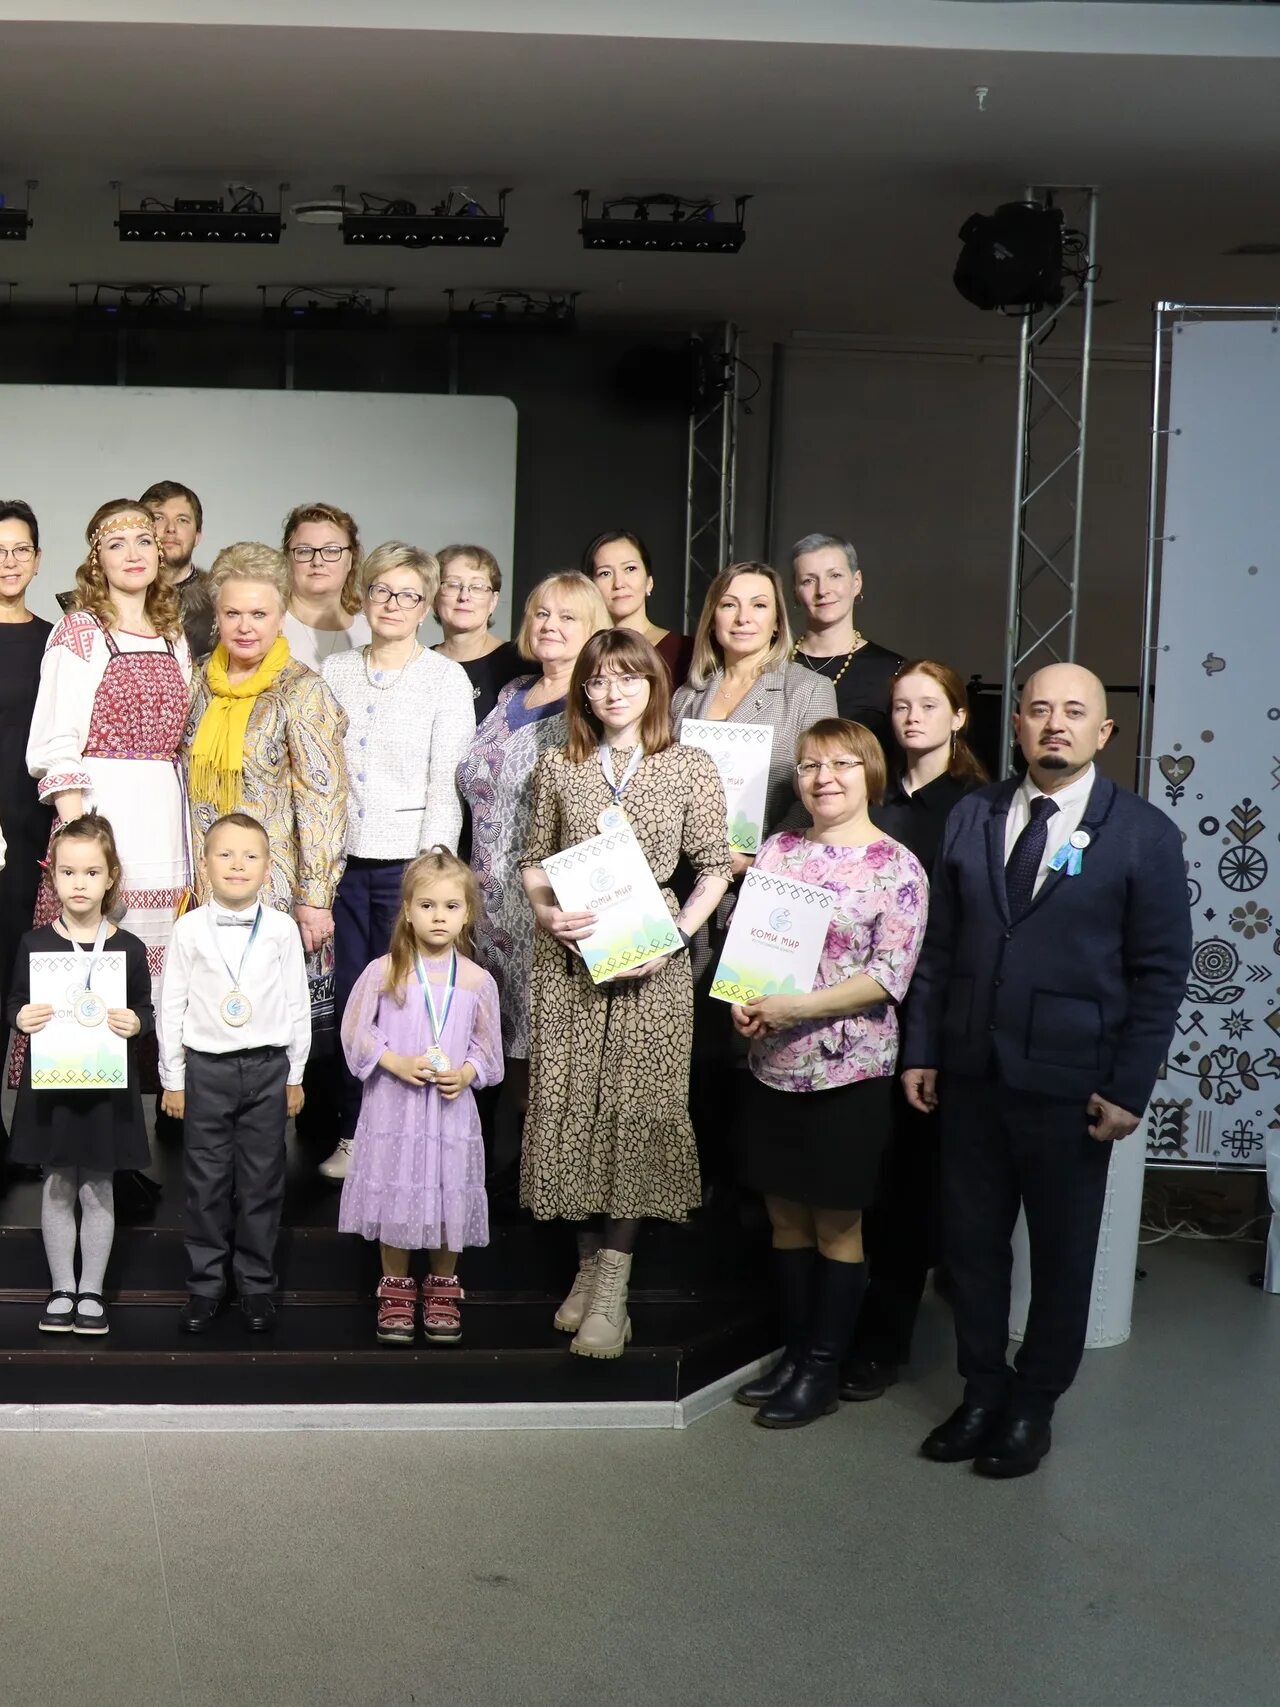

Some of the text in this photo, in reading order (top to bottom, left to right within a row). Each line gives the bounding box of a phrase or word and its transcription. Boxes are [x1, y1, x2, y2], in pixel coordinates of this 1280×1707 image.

[585, 893, 612, 911] КОМИ
[614, 884, 633, 898] МИР
[750, 927, 778, 942] КОМИ
[781, 937, 800, 949] МИР
